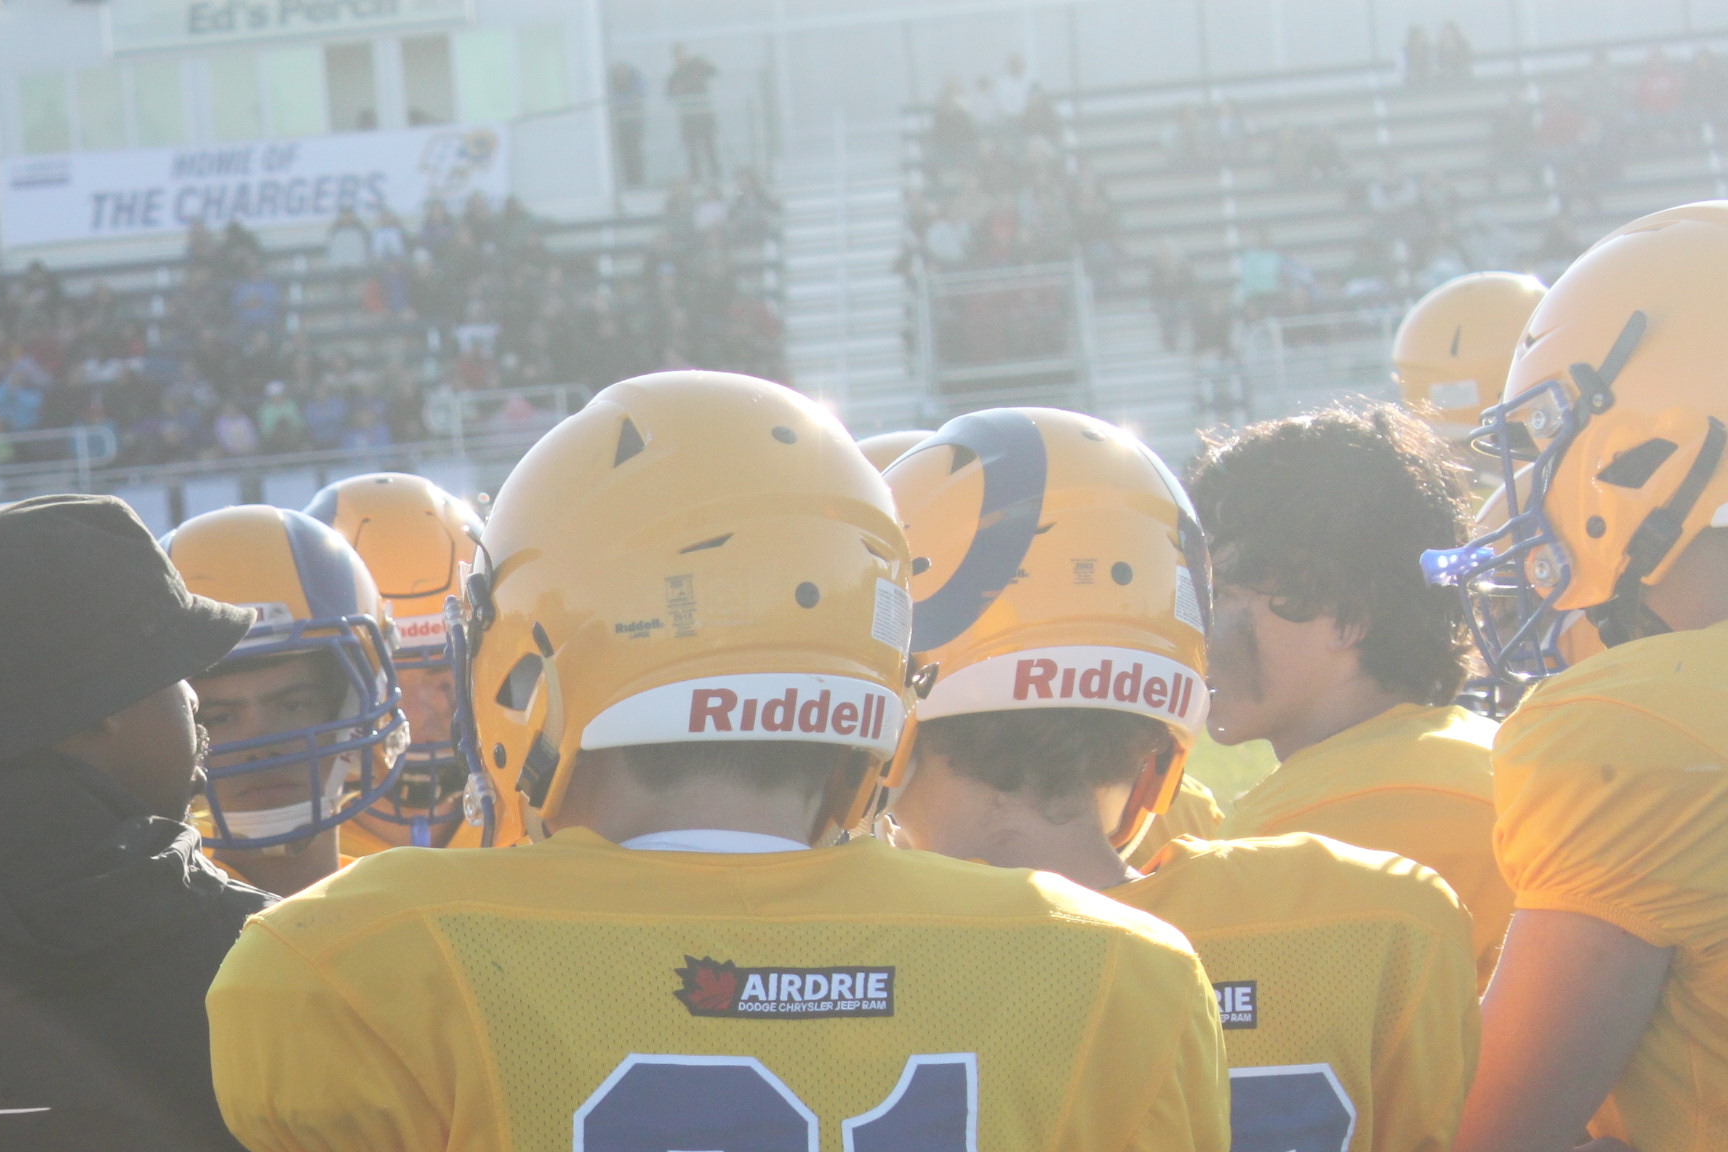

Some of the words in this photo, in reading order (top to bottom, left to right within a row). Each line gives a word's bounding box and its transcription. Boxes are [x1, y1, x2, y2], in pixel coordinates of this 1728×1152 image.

[90, 187, 165, 231] THE
[173, 170, 387, 224] CHARGERS
[688, 688, 886, 740] Riddell
[1013, 658, 1194, 719] Riddell
[738, 1002, 777, 1012] DODGE
[778, 1001, 834, 1012] CHRYSLER
[834, 1001, 860, 1011] JEEP
[862, 1001, 887, 1010] RAM
[740, 972, 889, 1001] AIRDRIE
